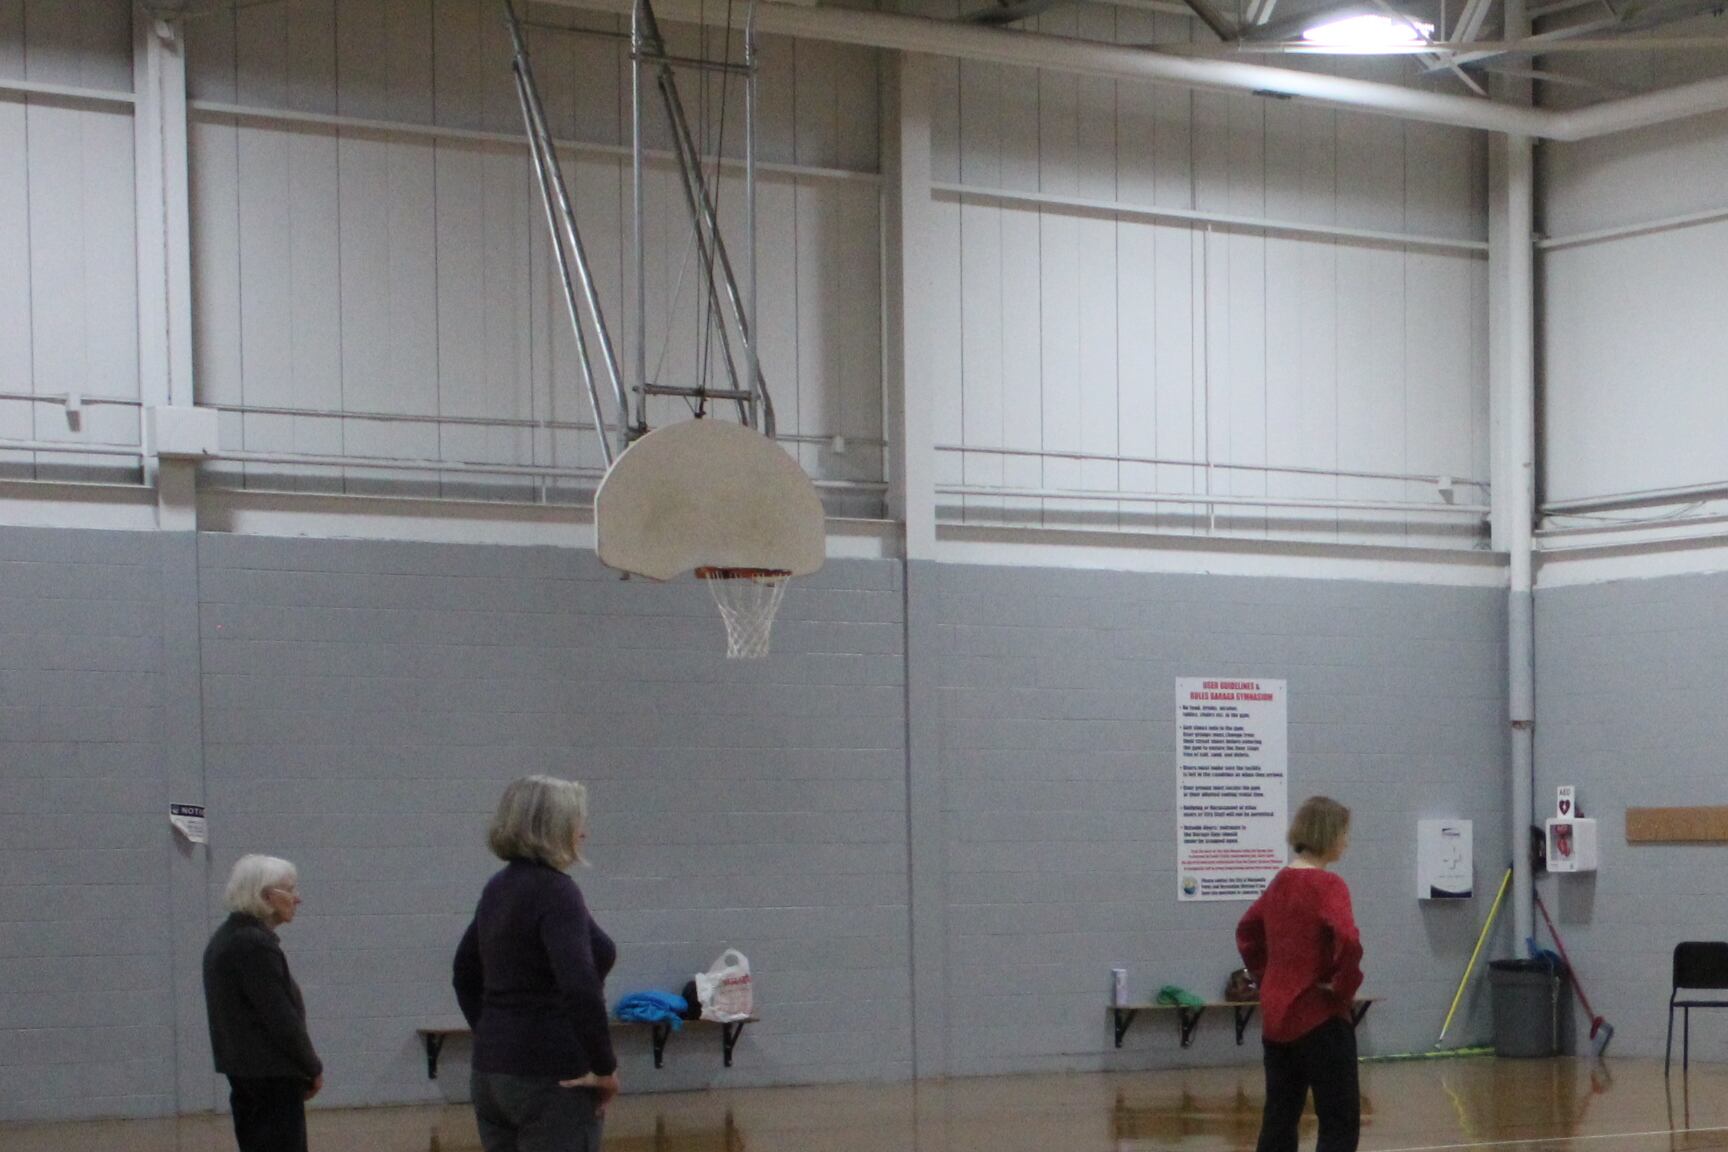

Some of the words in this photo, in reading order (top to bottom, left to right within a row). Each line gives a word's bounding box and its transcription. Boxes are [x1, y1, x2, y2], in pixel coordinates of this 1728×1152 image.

[1203, 681, 1219, 690] USER
[1220, 682, 1254, 690] GUIDELINES
[1559, 787, 1571, 796] AED
